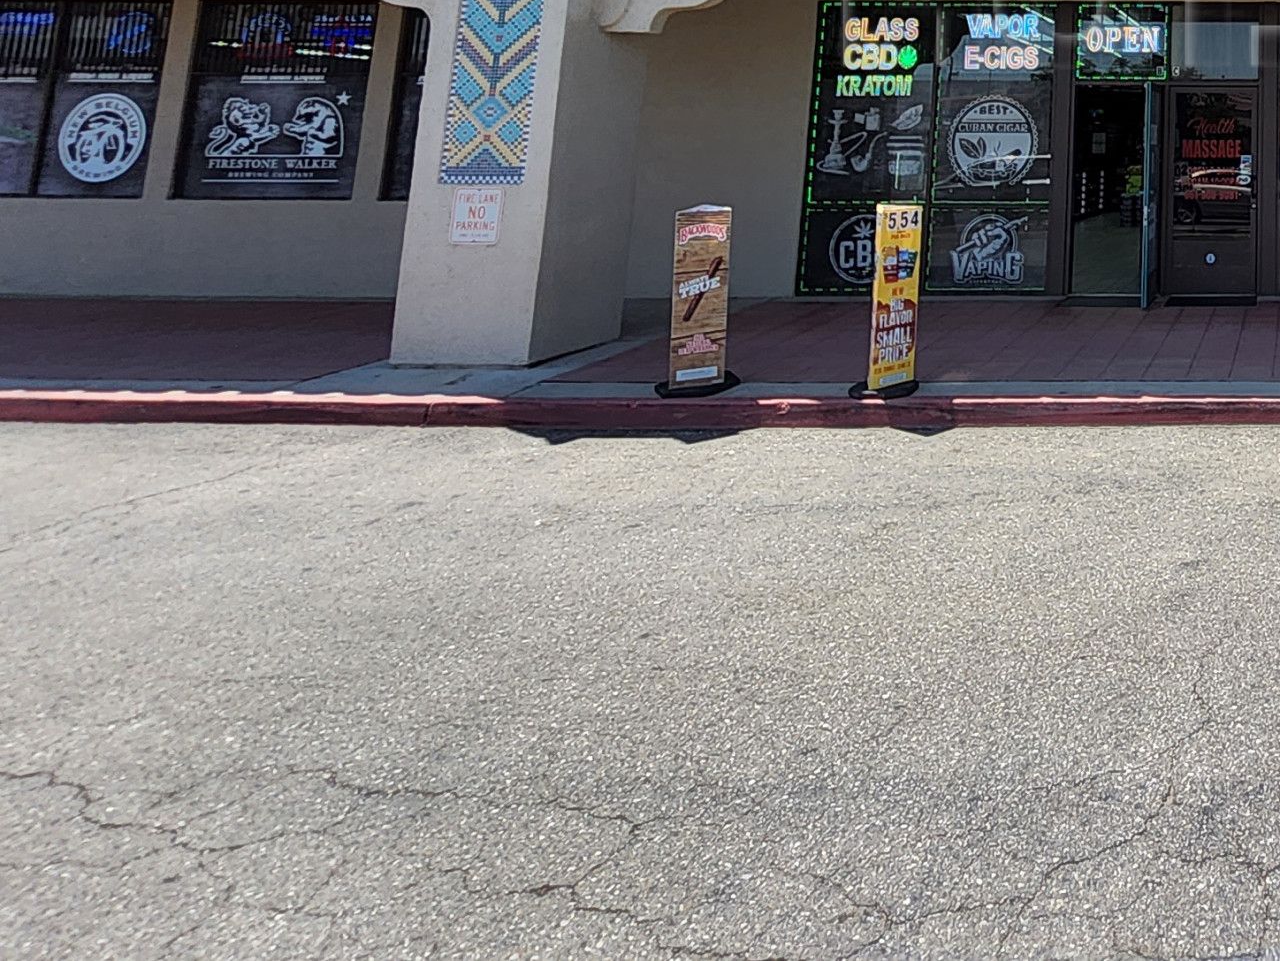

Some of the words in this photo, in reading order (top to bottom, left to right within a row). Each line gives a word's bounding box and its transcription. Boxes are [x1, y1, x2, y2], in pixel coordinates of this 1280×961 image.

[845, 17, 920, 42] GLASS
[965, 13, 1040, 39] VAPOR
[1086, 25, 1161, 53] OPEN
[843, 43, 899, 71] CBD
[964, 44, 1040, 70] E-CIGS
[836, 75, 914, 97] KRATOM
[67, 109, 88, 138] NEW
[94, 100, 140, 139] BELGIUM
[978, 104, 1010, 115] BEST
[958, 123, 994, 132] CUBAN
[996, 123, 1028, 132] CIGAR
[1187, 117, 1235, 138] Health
[1182, 139, 1241, 158] MASSAGE
[208, 158, 279, 169] FIRESTONE
[285, 158, 337, 169] WALKER
[468, 206, 486, 219] NO
[455, 221, 495, 231] PARKING
[679, 224, 727, 244] BACKWOODS
[838, 240, 876, 270] CB
[950, 249, 1025, 283] VAPING
[679, 277, 721, 298] TRUE
[890, 298, 905, 312] BIG
[879, 309, 913, 329] FLAVOR
[876, 326, 912, 349] SMALL
[878, 344, 911, 365] PRICE
